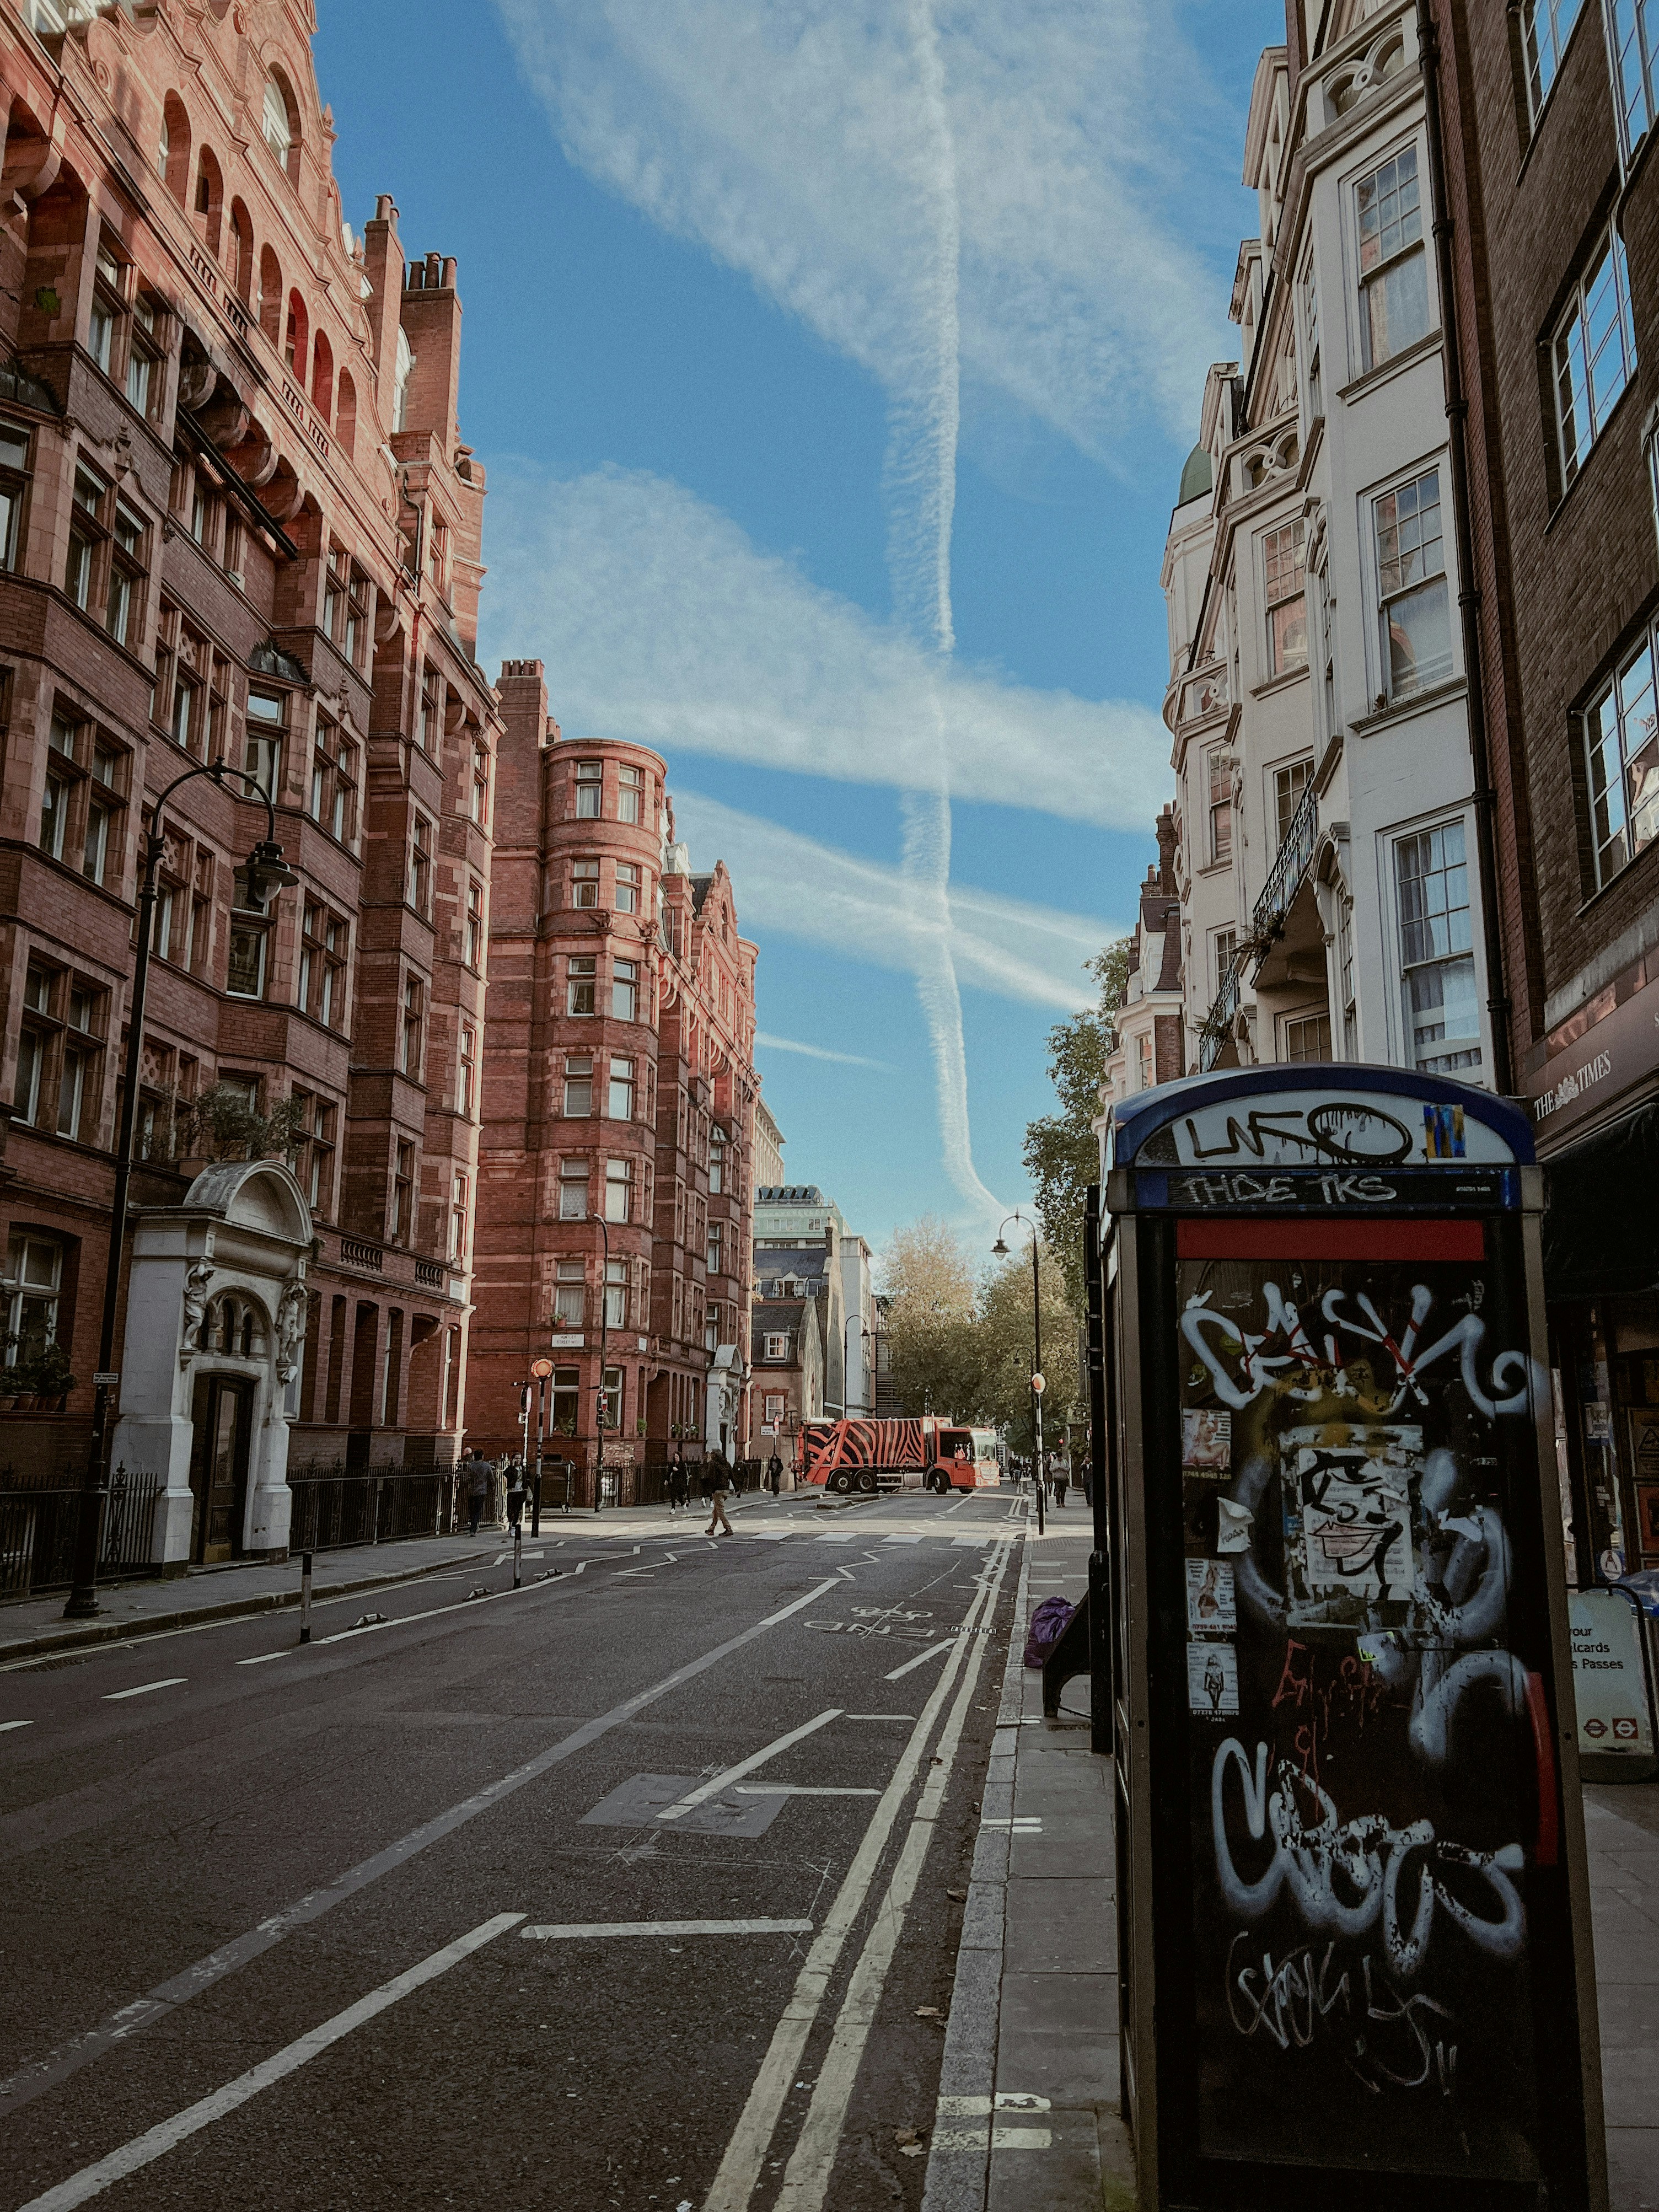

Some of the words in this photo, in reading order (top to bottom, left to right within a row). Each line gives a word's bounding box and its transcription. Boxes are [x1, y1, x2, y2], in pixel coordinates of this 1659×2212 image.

[1534, 1089, 1555, 1121] THE
[1577, 1050, 1612, 1092] TIMES
[1571, 1642, 1609, 1653] lcards
[1582, 1658, 1624, 1669] Passes
